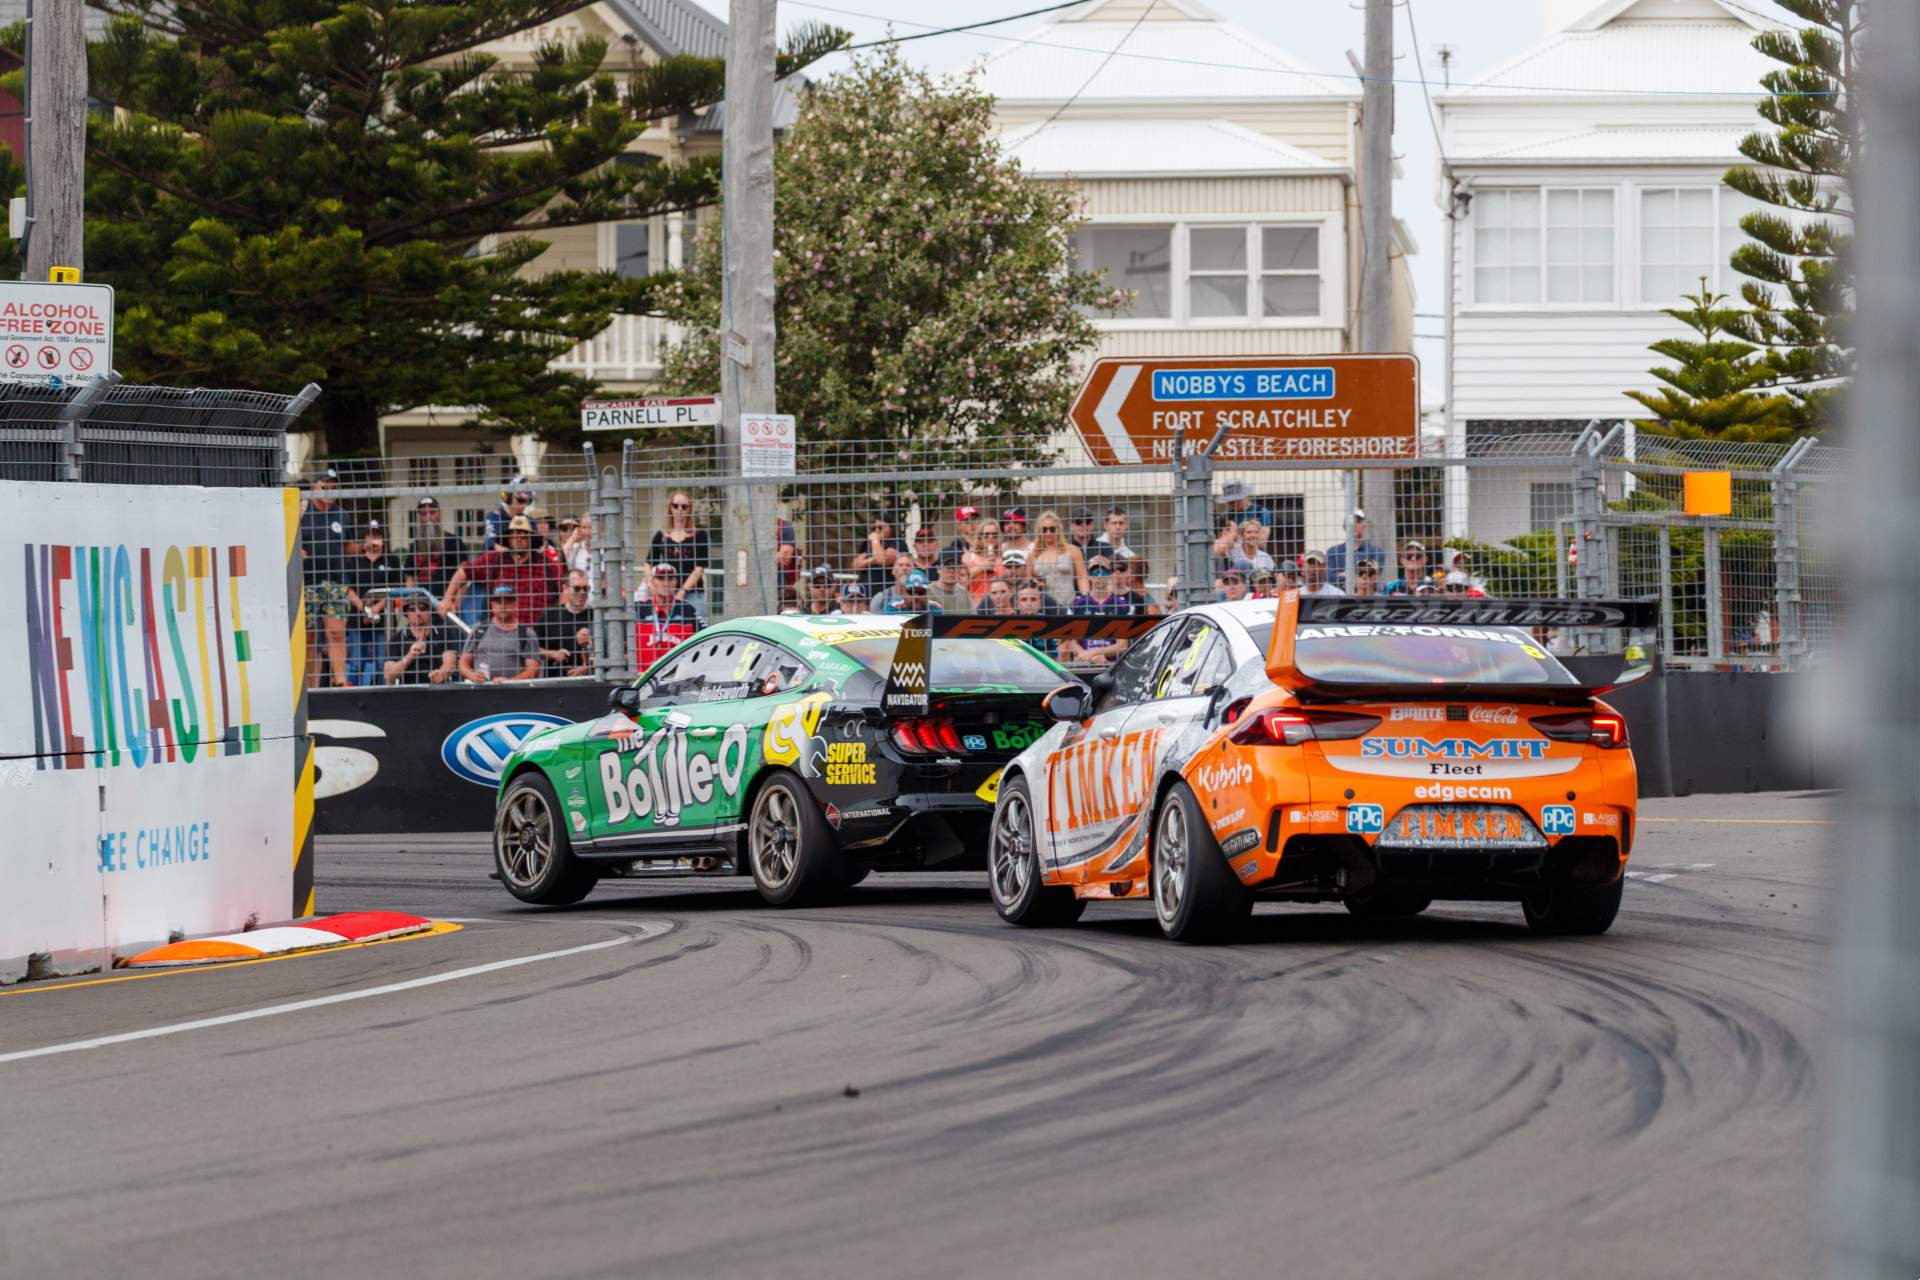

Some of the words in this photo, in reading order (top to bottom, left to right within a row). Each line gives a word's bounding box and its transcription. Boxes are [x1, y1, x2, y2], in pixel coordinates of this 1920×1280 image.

[3, 303, 98, 319] ALCOHOL
[49, 320, 104, 335] ZONE
[0, 371, 8, 379] he
[10, 371, 62, 381] Consumpt
[65, 373, 74, 381] of
[1161, 375, 1246, 395] NOBBYS
[1257, 373, 1327, 394] BEACH
[586, 400, 640, 410] NEWCASTLE
[644, 399, 669, 407] EAST
[586, 409, 667, 426] PARNELL
[676, 407, 698, 422] PL
[1153, 410, 1204, 430] FORT
[1216, 409, 1352, 430] SCRATCHLEY
[1287, 435, 1408, 457] FORESHORE
[1340, 607, 1597, 625] FREIGHTLINER
[944, 619, 1161, 639] FRAM
[25, 544, 261, 770] NEWCASTLE
[698, 682, 750, 702] Holdsworth
[887, 693, 928, 706] NAVIGATOR
[827, 742, 866, 763] SUPER
[1361, 736, 1550, 759] SUMMIT
[826, 763, 877, 785] SERVICE
[1198, 757, 1253, 792] Kubota
[1429, 763, 1483, 775] Fleet
[1045, 728, 1166, 832] TIMKEN
[1414, 782, 1512, 801] edgecam
[842, 807, 891, 820] INTERNATIONAL
[1300, 809, 1339, 818] LARSEN
[1401, 813, 1524, 838] TIMKEN
[96, 832, 127, 872] SEE
[136, 821, 209, 869] CHANGE
